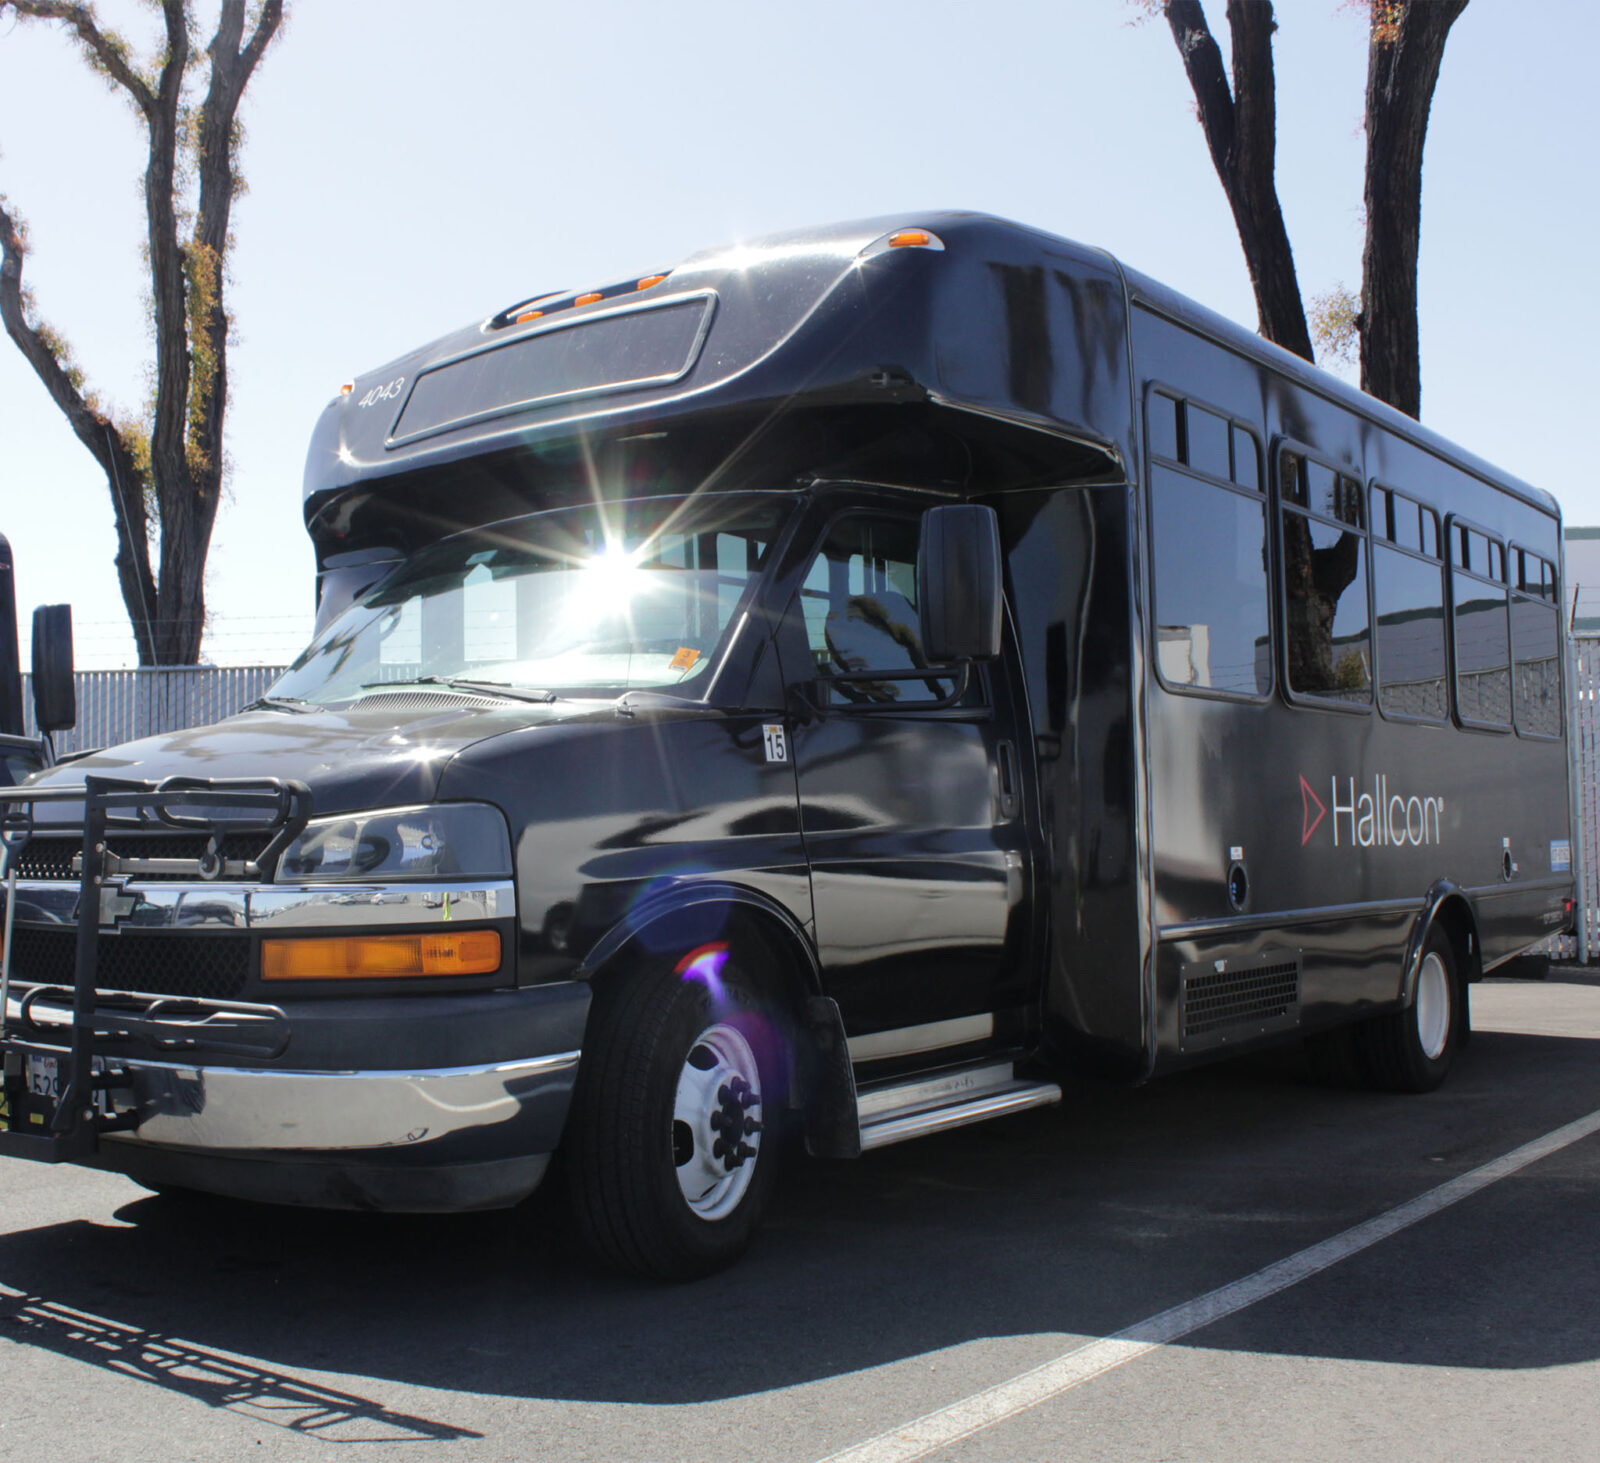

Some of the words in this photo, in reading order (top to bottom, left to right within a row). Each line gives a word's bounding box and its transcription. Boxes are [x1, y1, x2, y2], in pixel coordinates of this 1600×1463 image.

[358, 377, 405, 408] 4043
[767, 734, 785, 760] 15
[1332, 773, 1440, 847] Hallcon
